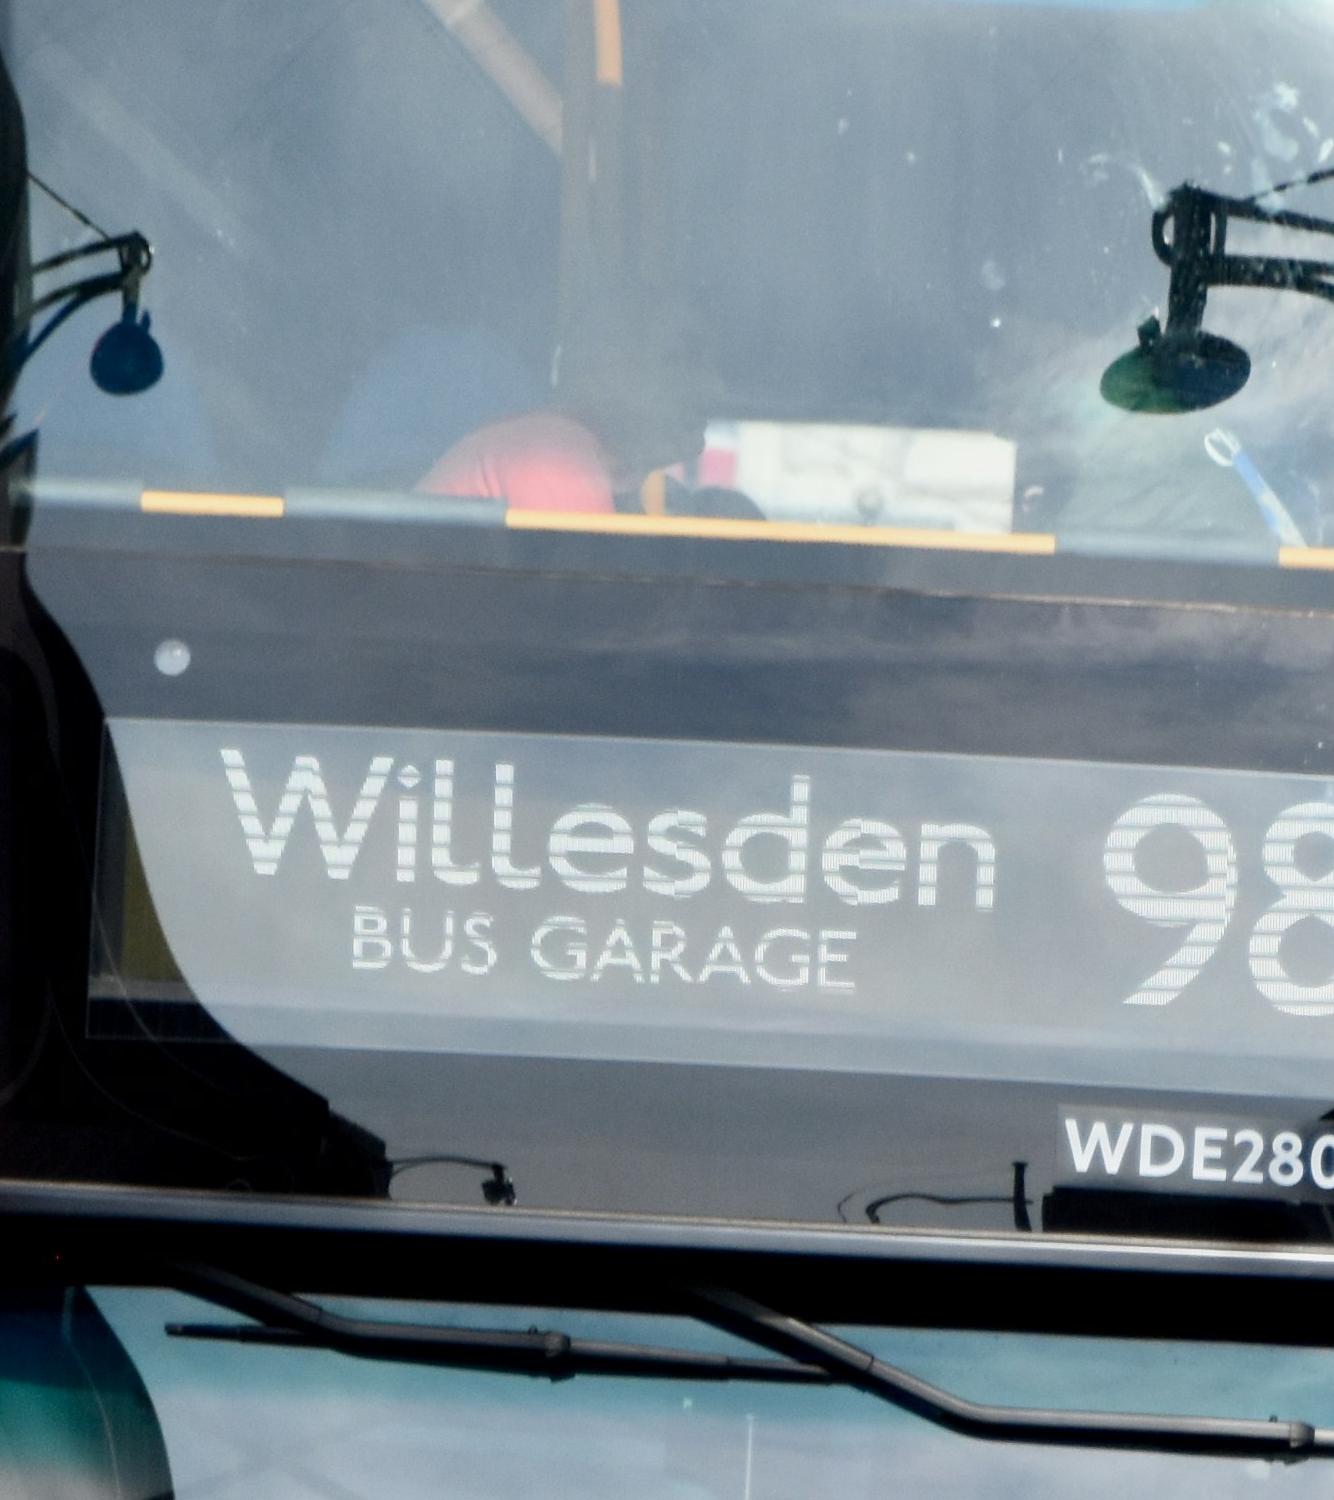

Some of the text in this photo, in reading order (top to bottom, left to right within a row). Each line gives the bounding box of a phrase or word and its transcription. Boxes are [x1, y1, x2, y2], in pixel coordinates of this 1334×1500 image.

[219, 747, 997, 911] Willesden
[351, 904, 859, 993] BUS GARAGE
